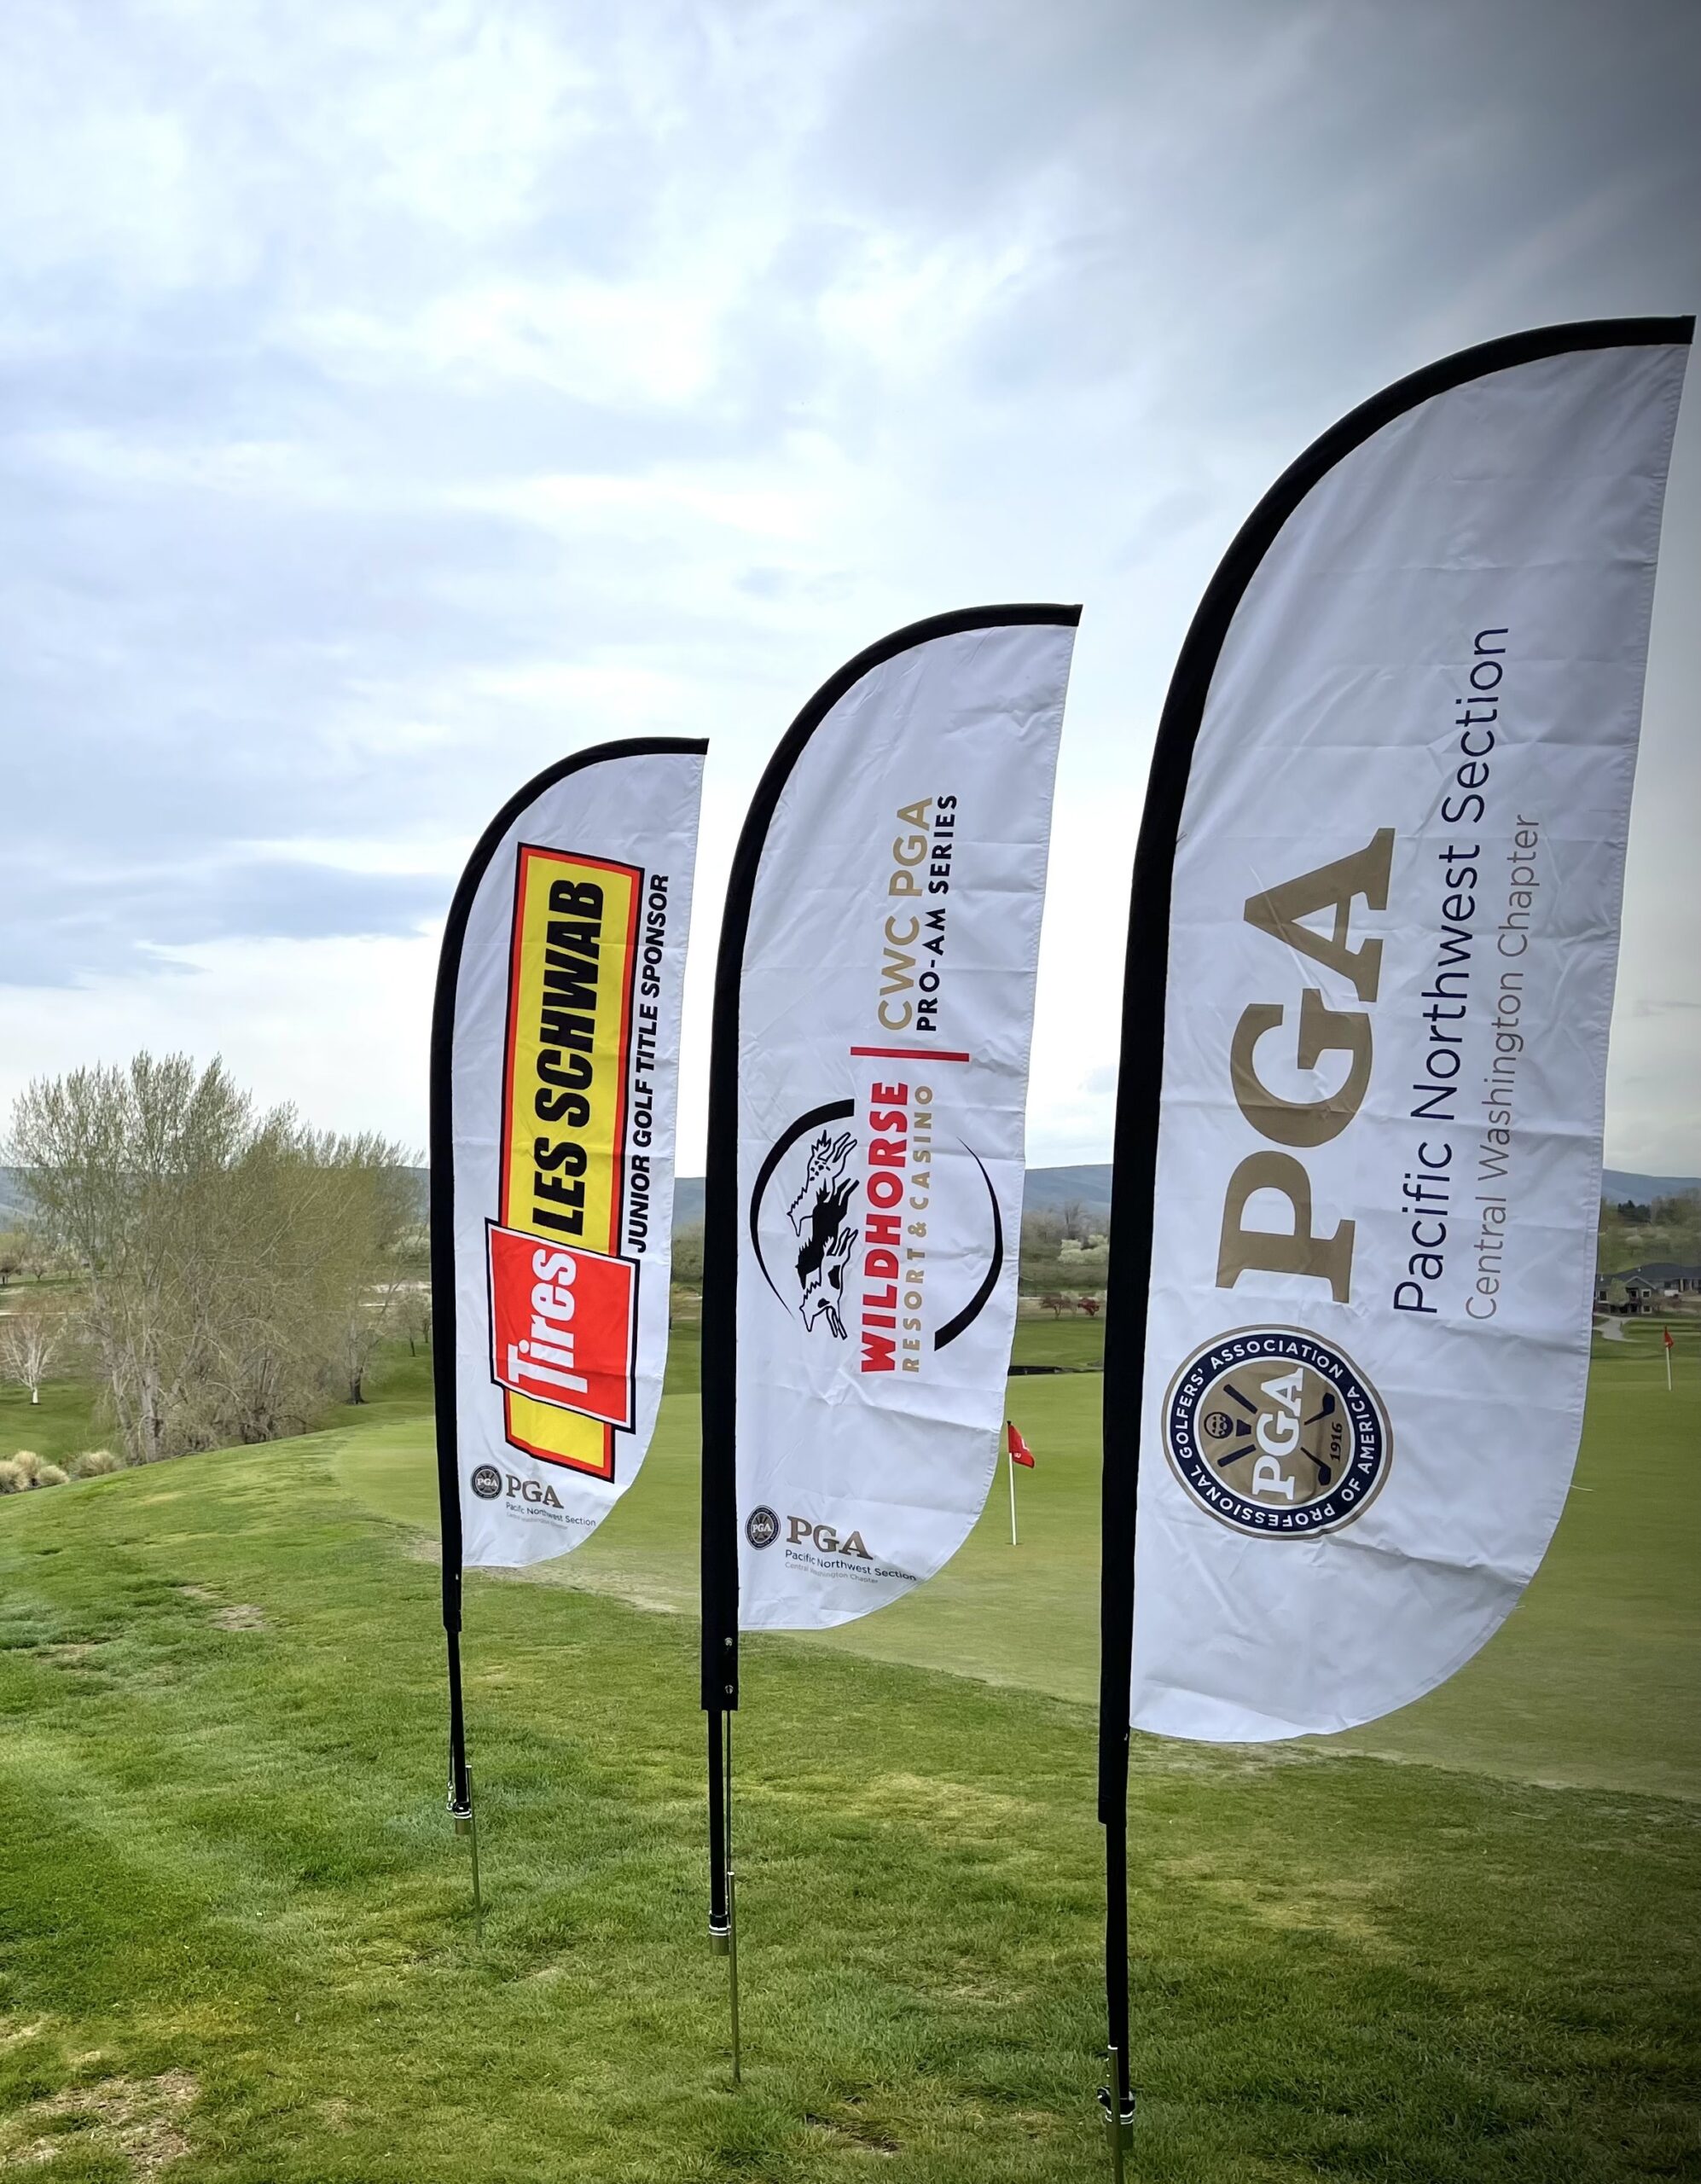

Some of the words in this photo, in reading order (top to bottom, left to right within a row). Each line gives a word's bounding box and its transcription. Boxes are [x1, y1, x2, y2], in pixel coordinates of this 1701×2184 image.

[1441, 628, 1509, 823] Section
[888, 797, 933, 897] PGA
[928, 795, 957, 895] SERIES
[1497, 813, 1540, 956] Chapter
[640, 874, 669, 998] SPONSOR
[878, 915, 920, 1031] CWC
[916, 908, 946, 1031] PRO-AM
[1410, 844, 1481, 1120] Northwest
[535, 880, 604, 1128] SCHWAB
[636, 1005, 658, 1075] TITLE
[632, 1079, 654, 1147] GOLF
[1215, 828, 1396, 1304] PGA
[1477, 972, 1524, 1182] Washington
[532, 1137, 588, 1236] LES
[909, 1085, 933, 1211] CASINO
[627, 1155, 651, 1253] JUNIOR
[861, 1082, 909, 1373] WILDHORSE
[907, 1221, 927, 1238] &
[1393, 1141, 1453, 1314] Pacific
[1466, 1196, 1507, 1320] Central
[508, 1248, 589, 1393] Tires
[903, 1248, 926, 1373] RESORT
[1210, 1339, 1344, 1380] ASSOCIATION
[1252, 1368, 1304, 1501] PGA
[1330, 1422, 1343, 1462] 1916
[1346, 1385, 1374, 1474] AMERICA
[477, 1478, 498, 1487] PGA
[506, 1473, 564, 1509] PGA
[565, 1515, 596, 1526] Section
[752, 1523, 773, 1533] PGA
[1190, 1464, 1336, 1527] PROFESSIONAL
[1341, 1478, 1361, 1502] OF
[785, 1549, 816, 1565] Pacific
[816, 1558, 872, 1575] Northwest
[874, 1567, 917, 1582] Section
[786, 1515, 874, 1560] PGA
